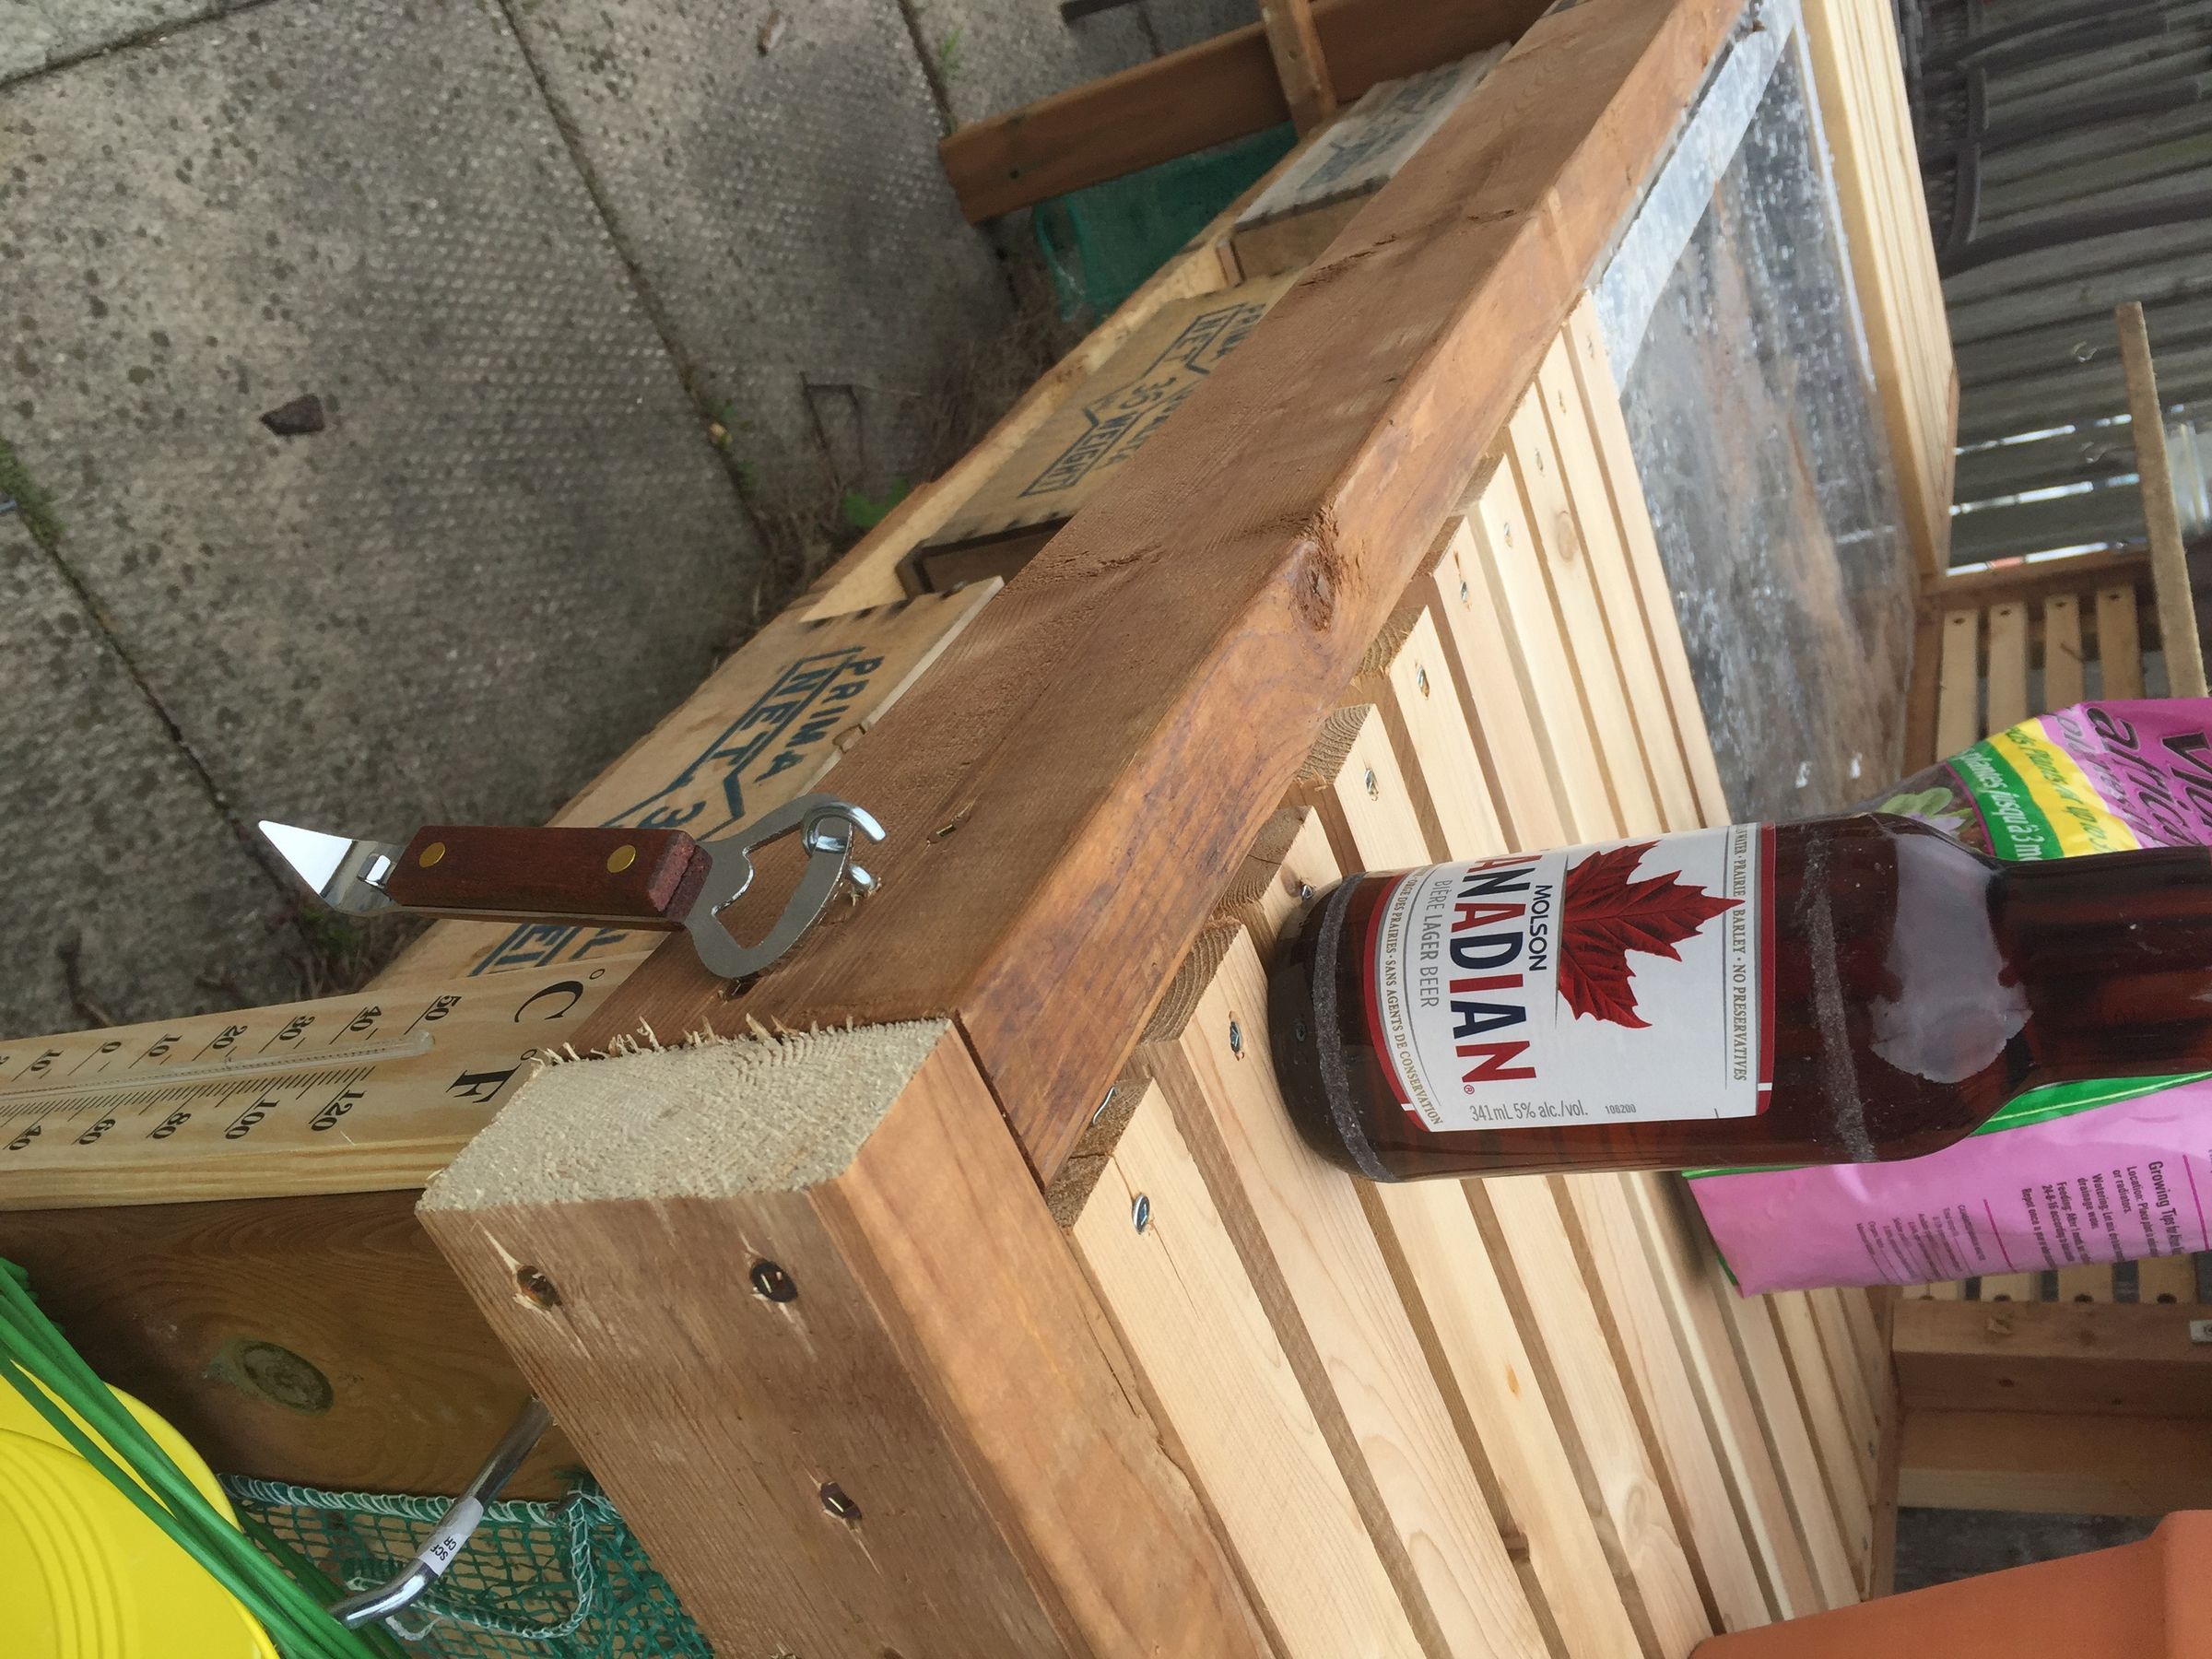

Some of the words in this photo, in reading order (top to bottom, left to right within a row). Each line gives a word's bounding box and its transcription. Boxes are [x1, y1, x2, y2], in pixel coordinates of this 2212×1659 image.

[709, 668, 825, 766] NET
[1959, 747, 2007, 791] plantes
[2010, 832, 2045, 843] 3
[1733, 859, 1747, 897] PRAIRIE
[1394, 895, 1411, 912] DES
[1385, 910, 1402, 954] PRAIRIES
[1420, 913, 1443, 960] LAGER
[1528, 885, 1554, 971] MOLSON
[1732, 909, 1747, 955] BARLEY
[1385, 959, 1398, 986] SANS
[1449, 854, 1543, 1083] ANADIAN
[1733, 964, 1746, 986] NO
[1419, 966, 1441, 1008] BEER
[349, 1006, 382, 1032] 40
[425, 994, 461, 1021] 50
[1386, 988, 1403, 1032] AGENTS
[212, 1025, 248, 1050] 20
[278, 1016, 315, 1041] 30
[1394, 1034, 1407, 1049] DE
[1733, 987, 1747, 1081] PRESERVATIVES
[30, 1050, 65, 1072] 10
[100, 1041, 122, 1054] 0
[148, 1034, 182, 1058] 10
[1399, 1049, 1444, 1126] CONSERVATION
[225, 1099, 280, 1140] 100
[311, 1089, 366, 1132] 120
[1513, 1101, 1536, 1119] 5%
[1537, 1100, 1589, 1118] alc./vol.
[8, 1124, 42, 1151] 40
[78, 1118, 116, 1146] 60
[152, 1112, 192, 1140] 80
[2112, 1169, 2123, 1178] or
[2148, 1160, 2171, 1207] Growing
[2077, 1177, 2094, 1210] drainage
[2126, 1166, 2144, 1202] Location:
[2138, 1202, 2149, 1221] Place
[2159, 1207, 2178, 1227] Tips
